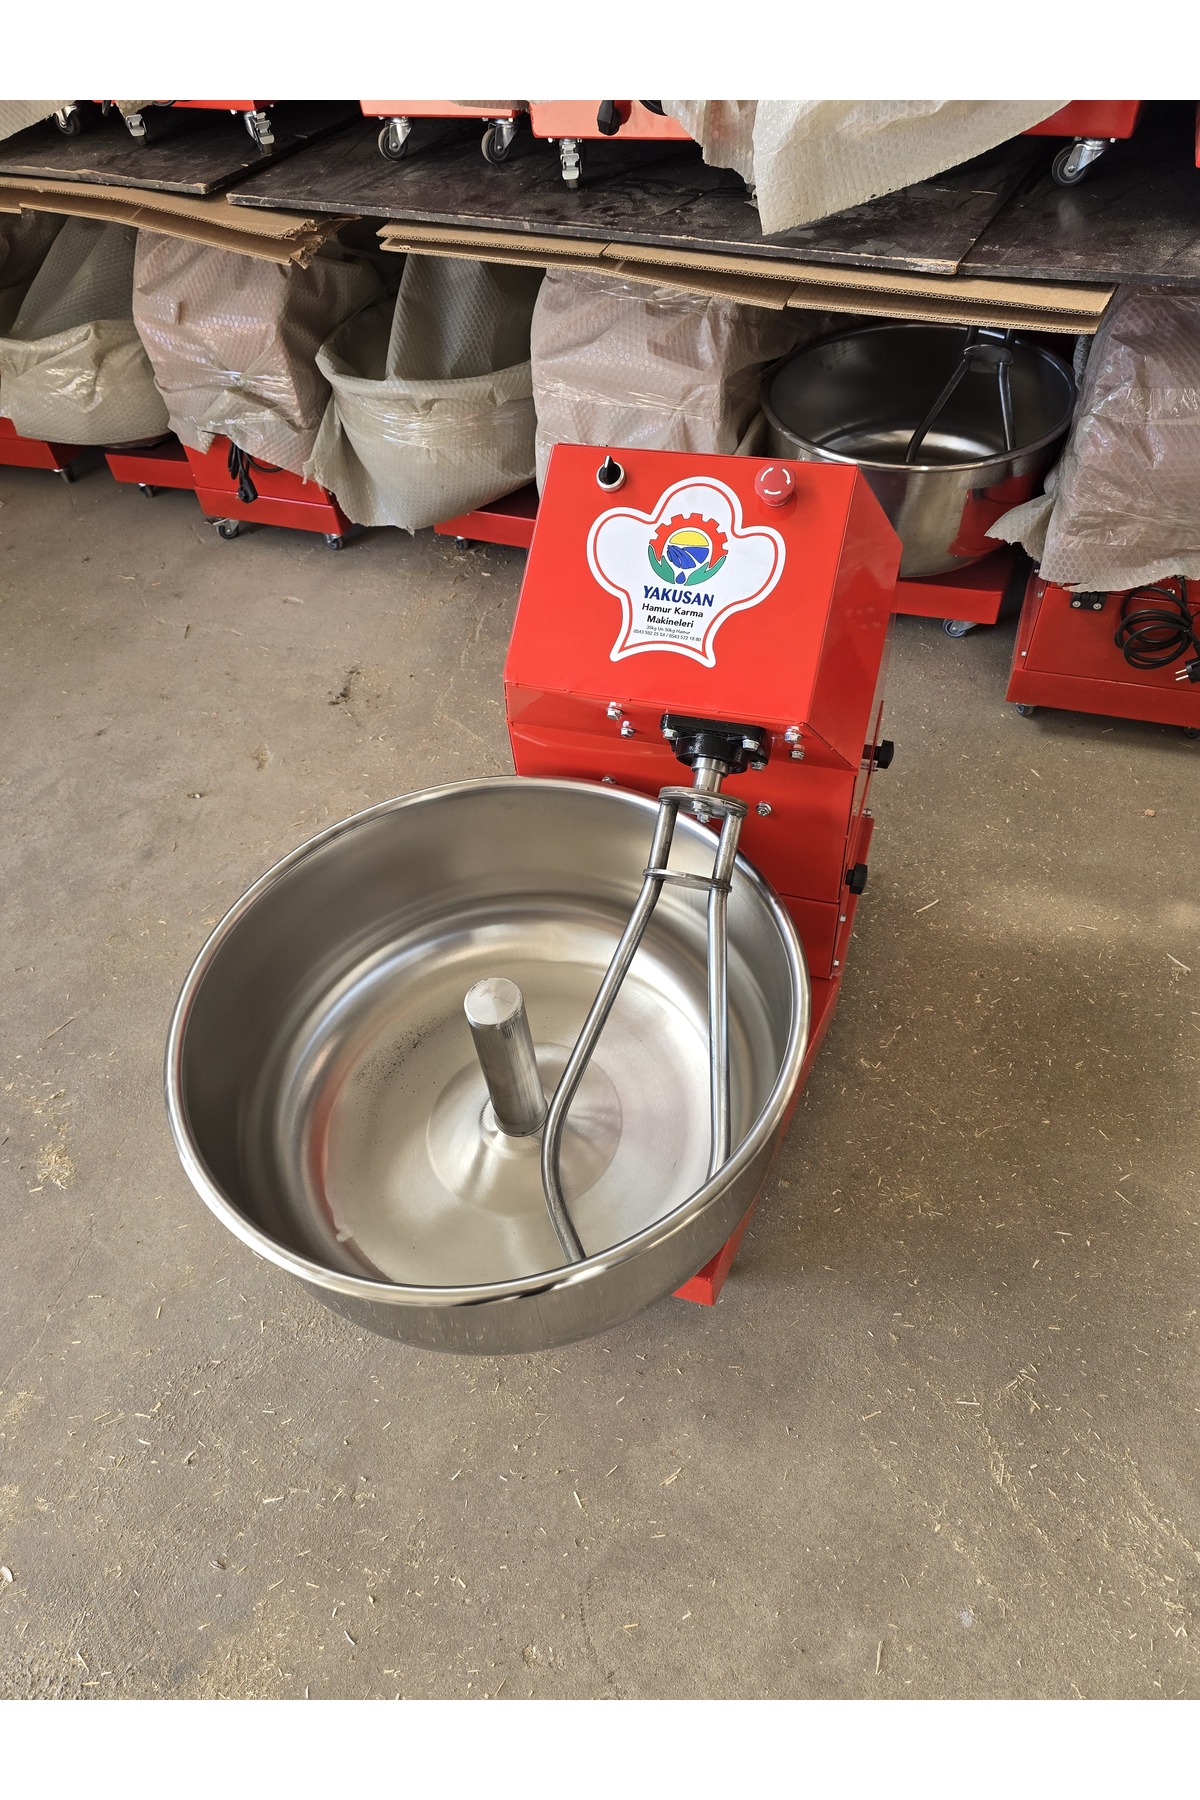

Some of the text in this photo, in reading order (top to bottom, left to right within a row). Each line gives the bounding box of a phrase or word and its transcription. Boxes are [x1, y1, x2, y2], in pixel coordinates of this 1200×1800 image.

[644, 585, 714, 608] YAKUSAN
[642, 603, 704, 618] Hamur Karma
[646, 615, 694, 628] Makineleri
